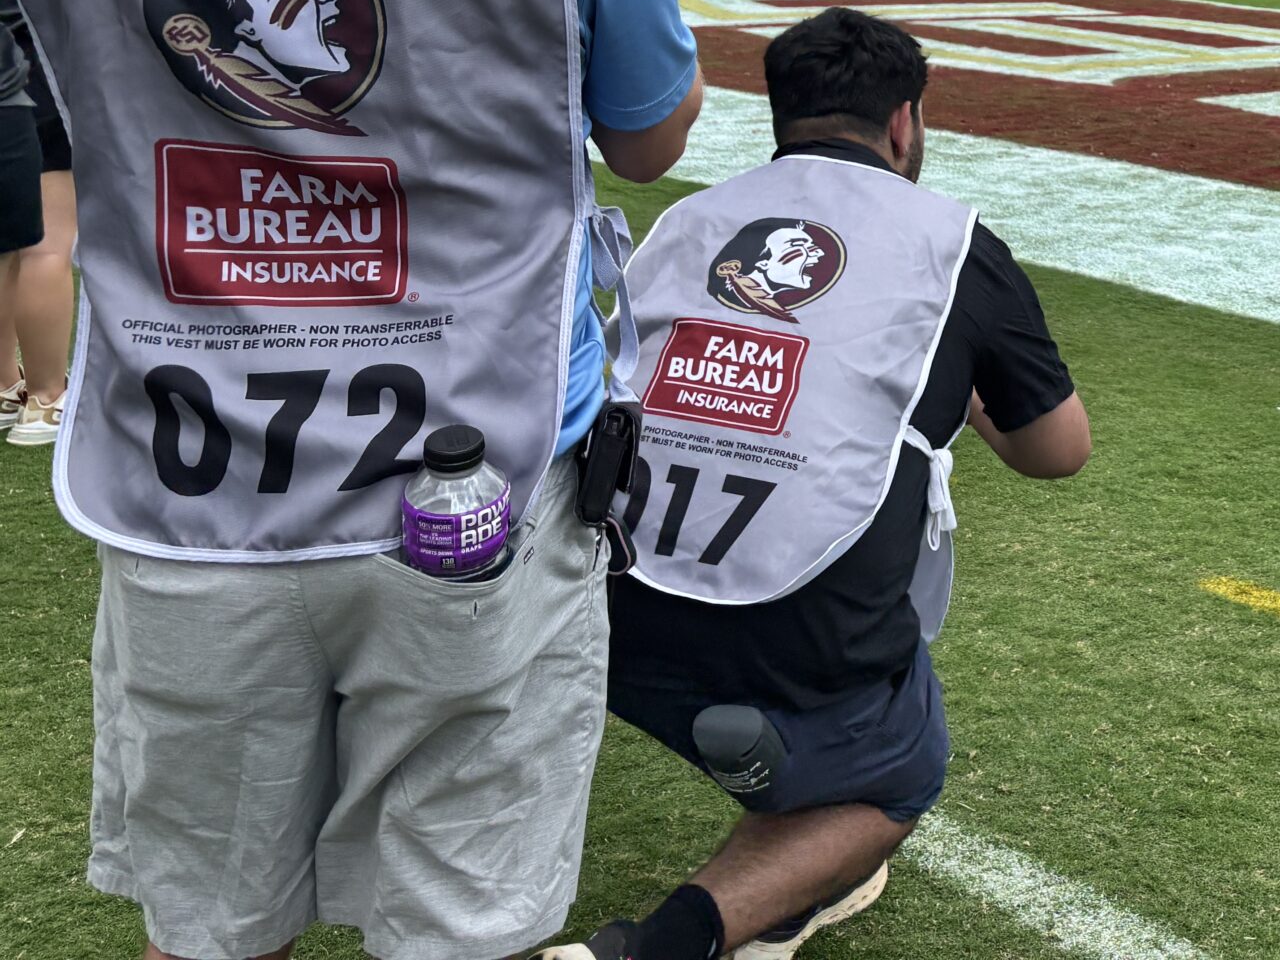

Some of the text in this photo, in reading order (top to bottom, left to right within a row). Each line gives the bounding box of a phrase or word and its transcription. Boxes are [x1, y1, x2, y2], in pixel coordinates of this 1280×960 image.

[240, 168, 378, 206] FARM
[184, 205, 382, 245] BUREAU
[221, 259, 382, 284] INSURANCE
[122, 319, 185, 334] OFFICIAL
[188, 324, 297, 336] PHOTOGRAPHER
[309, 325, 340, 335] NON
[343, 314, 454, 335] TRANSFERRABLE
[132, 330, 442, 351] THIS VEST MUST BE WORN FOR PHOTO ACCESS
[703, 335, 784, 370] FARM
[667, 356, 783, 395] BUREAU
[676, 389, 774, 419] INSURANCE
[143, 363, 427, 497] 072
[643, 425, 711, 445] PHOTOGRAPHER
[716, 438, 734, 449] NON
[736, 442, 808, 464] TRANSFERRABLE
[652, 436, 674, 447] MUST
[675, 440, 687, 450] BE
[688, 444, 713, 455] WORN
[715, 448, 732, 458] FOR
[733, 451, 762, 464] PHOTO
[763, 458, 798, 471] ACCESS
[461, 516, 502, 548] ADE
[461, 544, 482, 554] GRAPE
